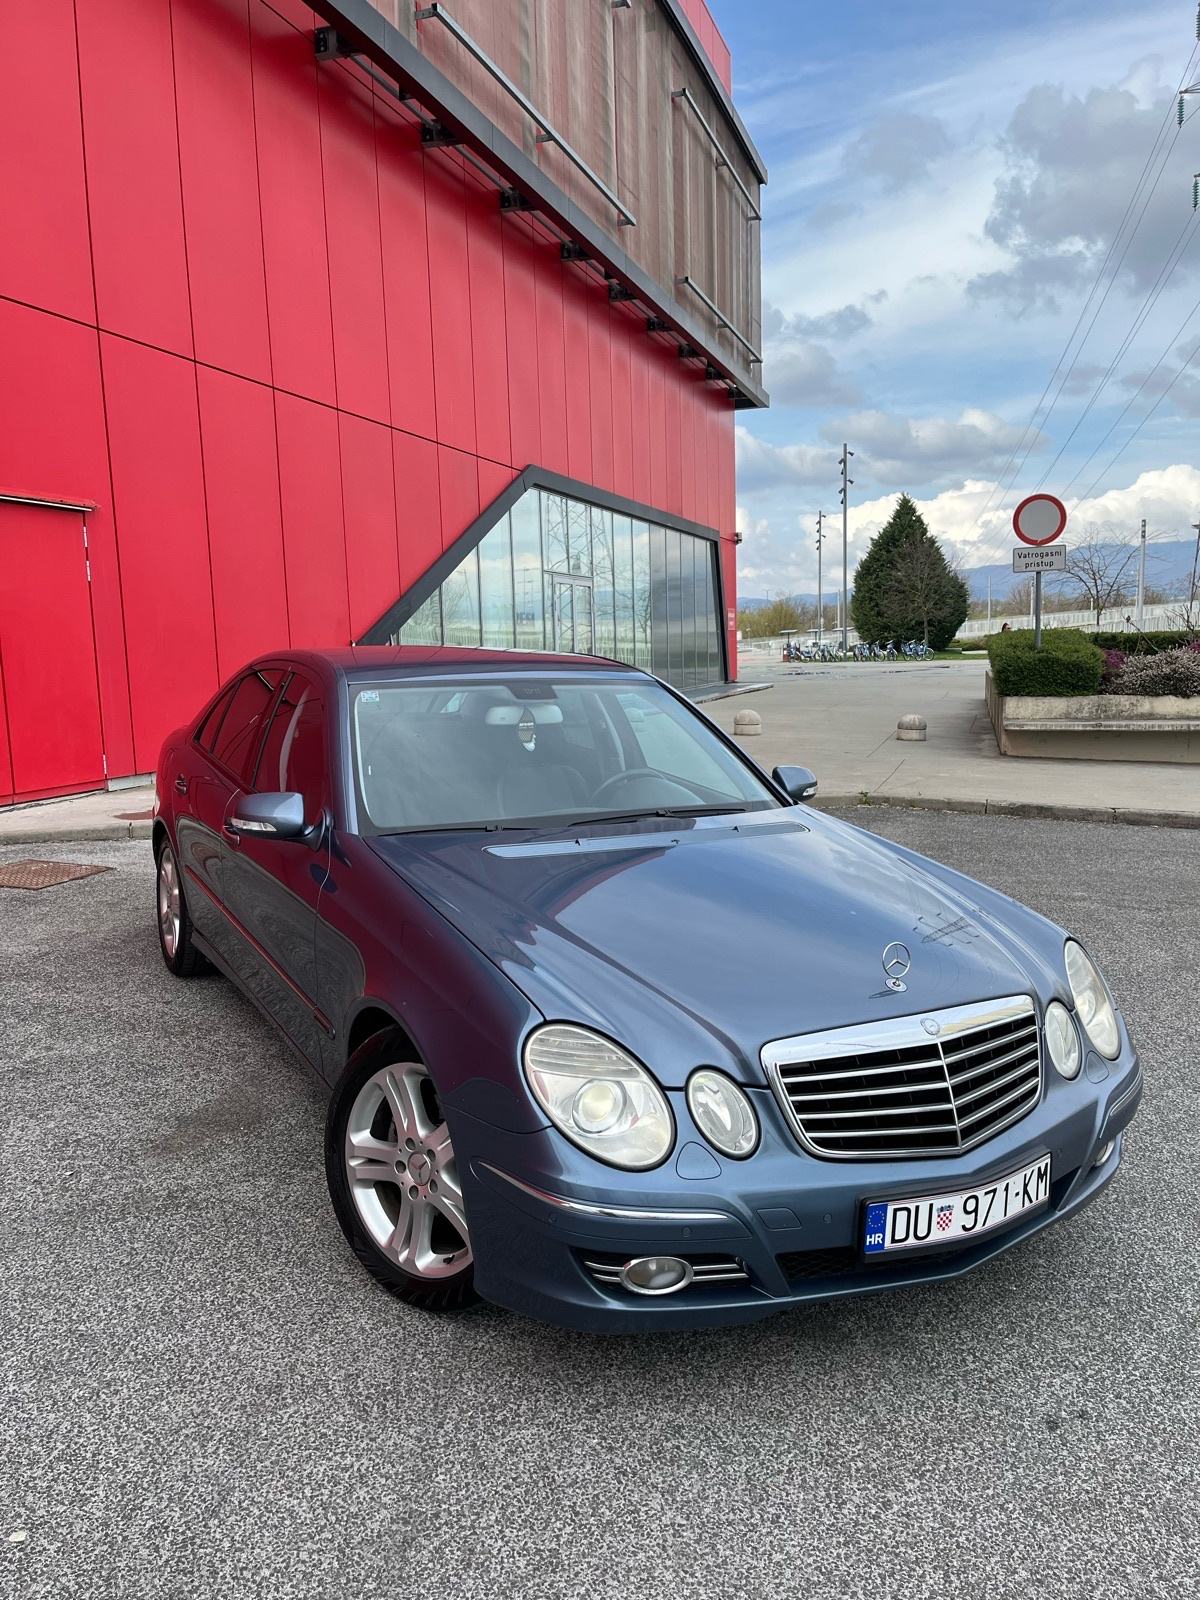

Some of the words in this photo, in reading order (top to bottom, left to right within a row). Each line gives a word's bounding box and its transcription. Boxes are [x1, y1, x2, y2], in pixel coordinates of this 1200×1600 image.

[1017, 549, 1062, 559] Vatrogasni
[1025, 560, 1054, 569] pristup
[890, 1203, 934, 1244] DU
[961, 1162, 1050, 1232] 971-KM
[866, 1233, 883, 1246] HR
